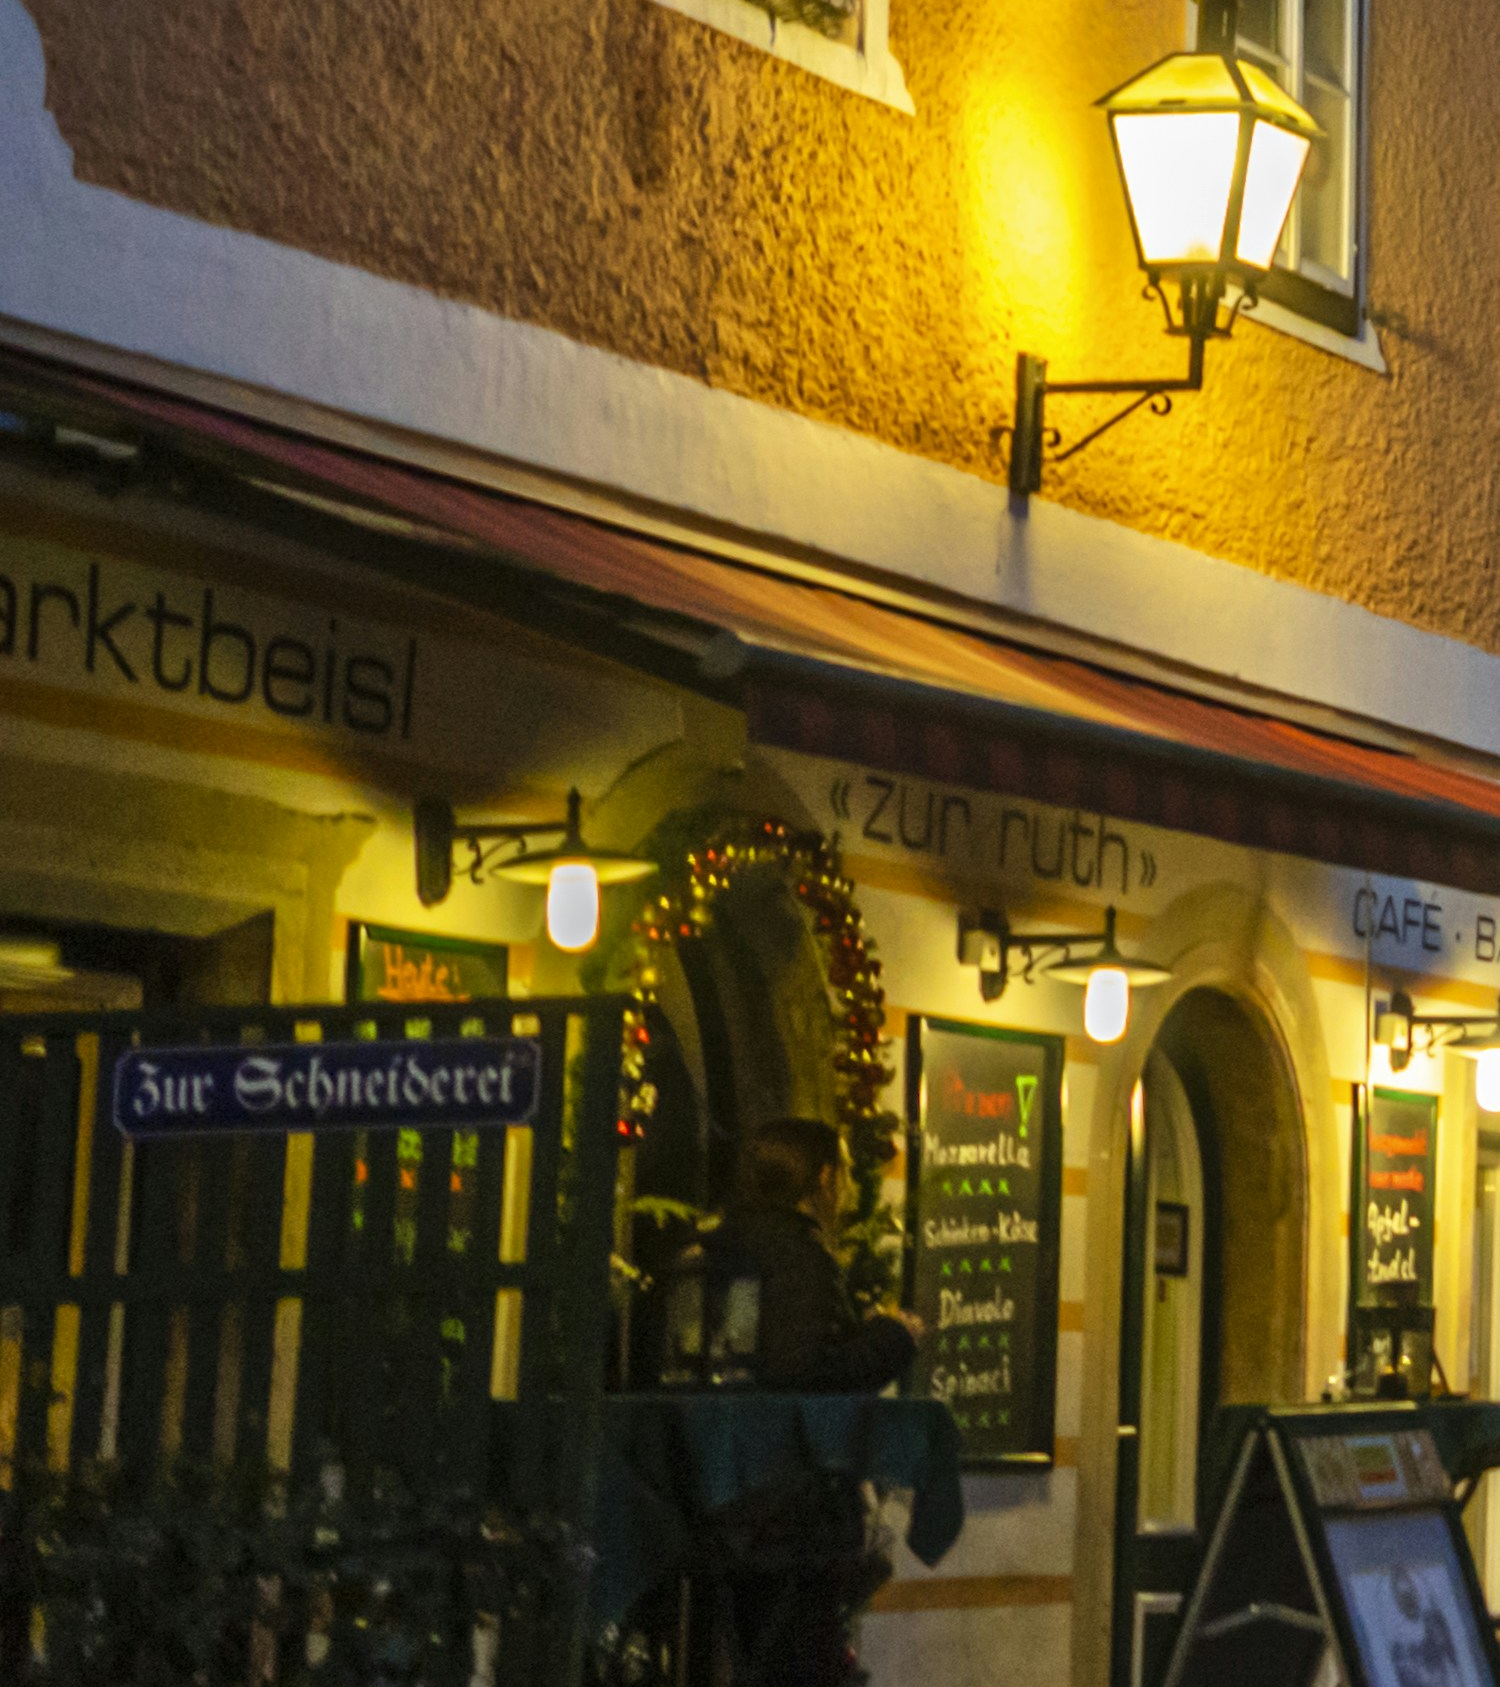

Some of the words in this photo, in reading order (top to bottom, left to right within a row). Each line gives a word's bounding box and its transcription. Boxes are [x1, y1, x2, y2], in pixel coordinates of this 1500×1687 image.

[1352, 887, 1442, 952] CAFÉ
[132, 1060, 214, 1117] Zur
[234, 1055, 512, 1119] Schneiderei
